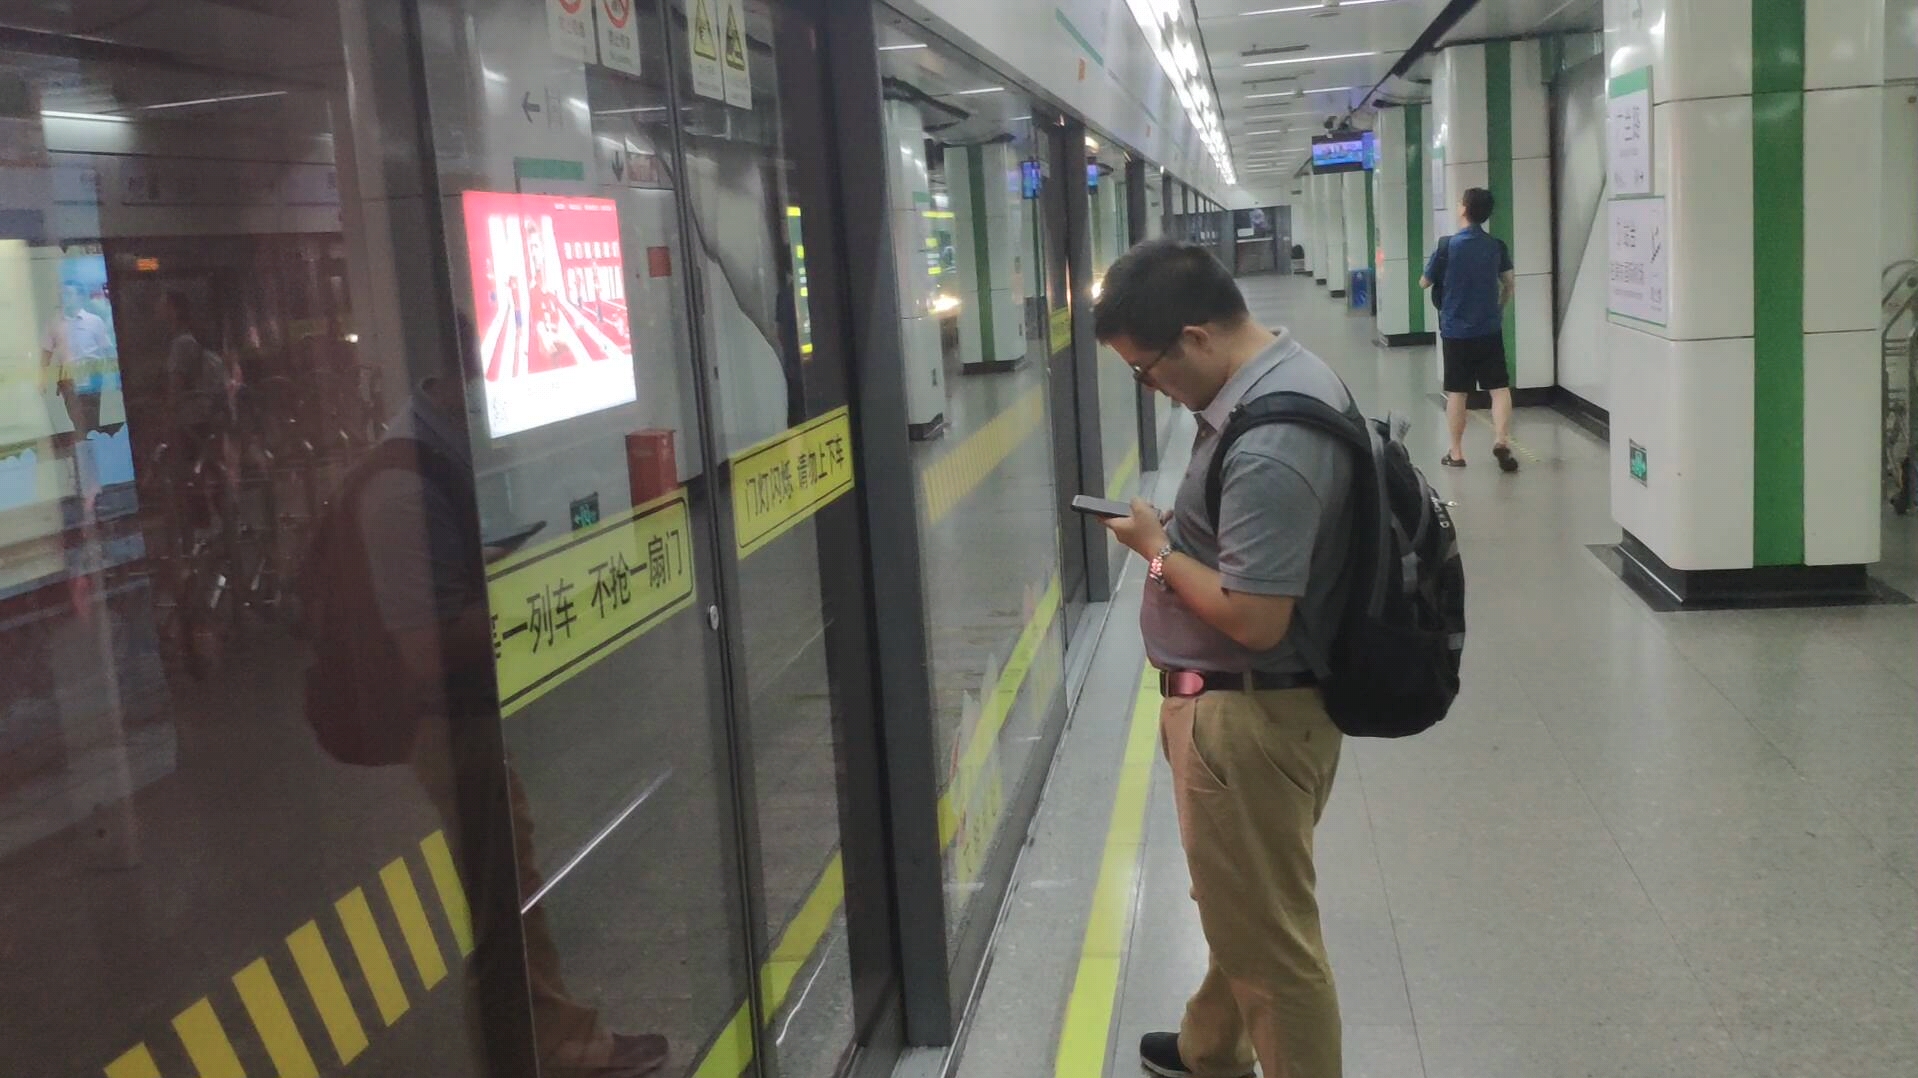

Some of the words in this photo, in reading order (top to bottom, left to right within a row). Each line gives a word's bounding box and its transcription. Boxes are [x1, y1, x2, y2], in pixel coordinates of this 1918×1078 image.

[588, 529, 682, 619] 不抢一扇门
